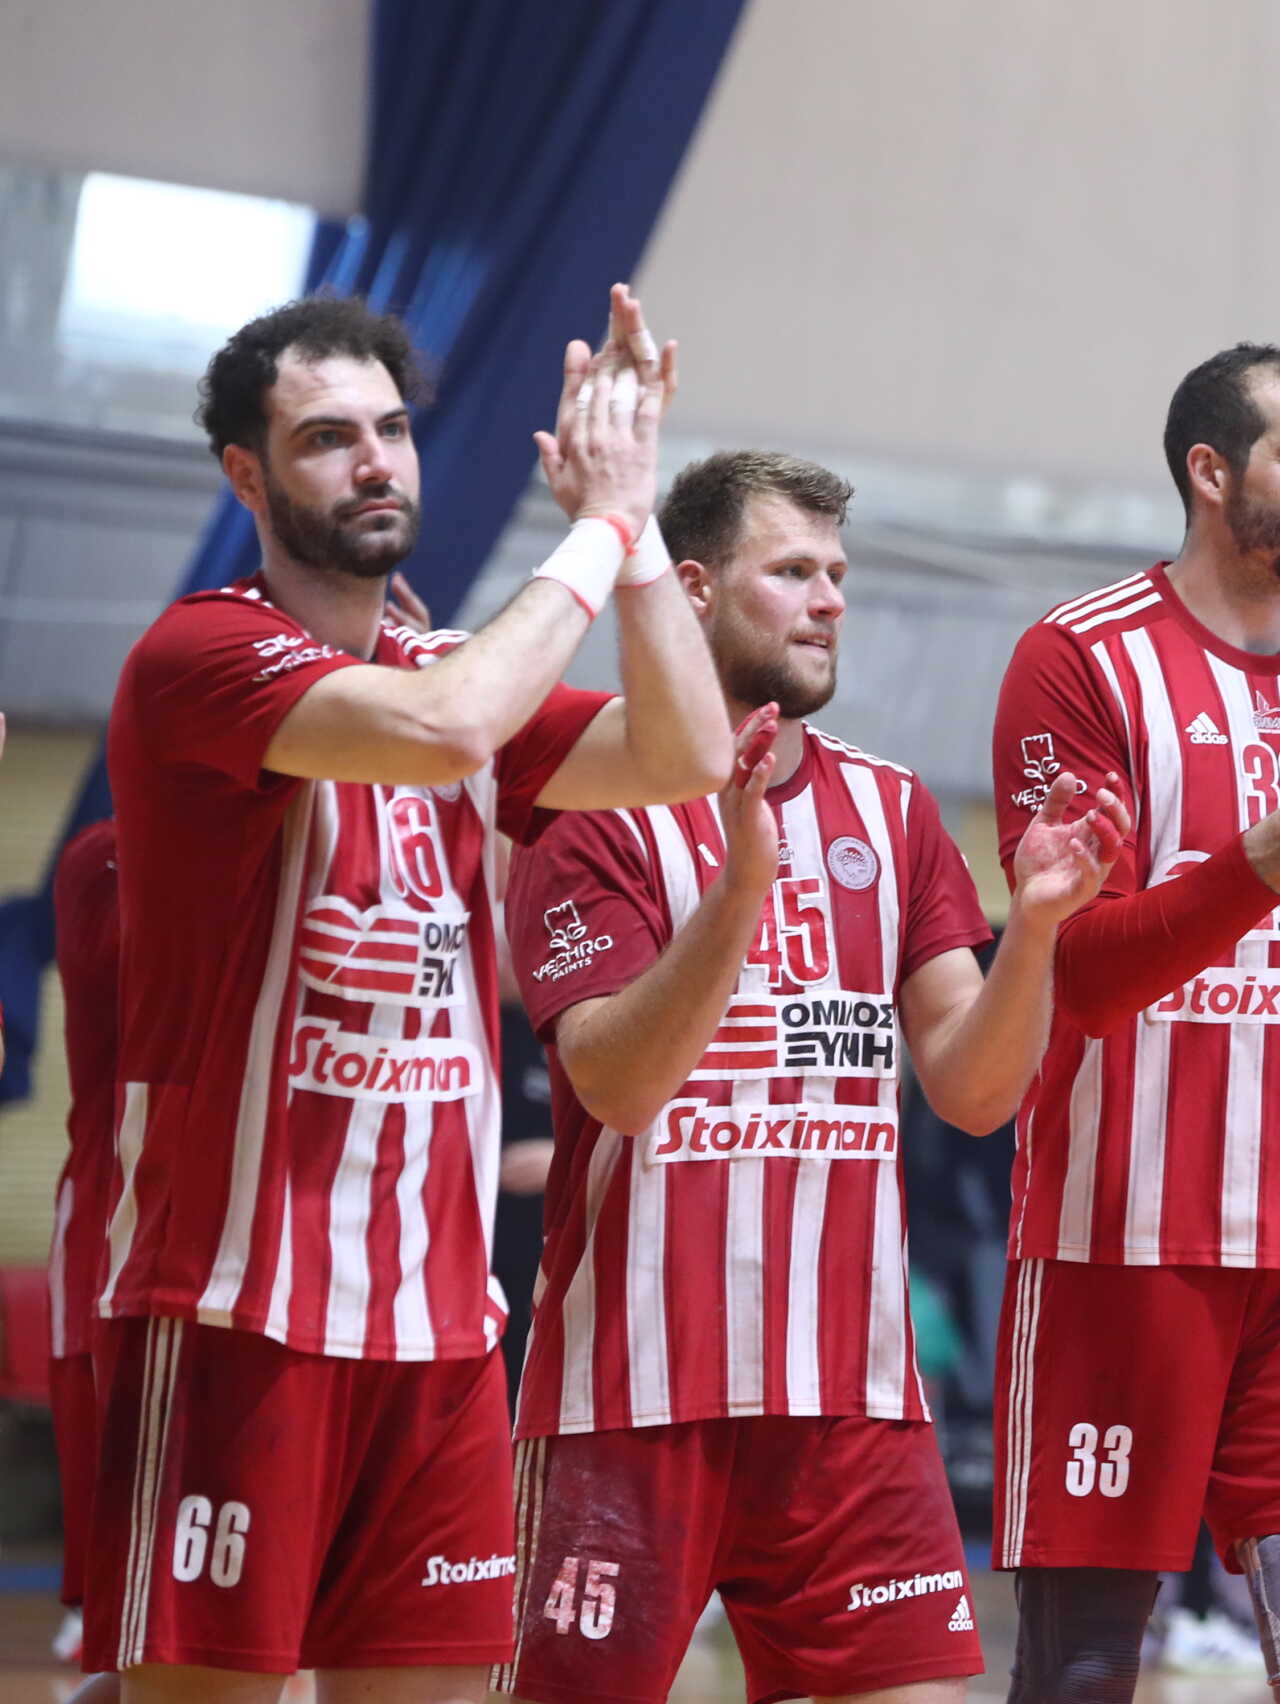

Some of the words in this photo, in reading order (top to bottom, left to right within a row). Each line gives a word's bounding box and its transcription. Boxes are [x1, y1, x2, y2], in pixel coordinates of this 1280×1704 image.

[1190, 733, 1229, 745] adidas
[744, 877, 832, 988] 45
[532, 935, 614, 983] VECHRO
[784, 1031, 894, 1069] ΞΥΝΗ
[655, 1105, 896, 1155] Stoiximan
[1065, 1423, 1133, 1498] 33
[171, 1494, 251, 1588] 66
[543, 1556, 621, 1640] 45
[847, 1569, 963, 1612] Stoiximan
